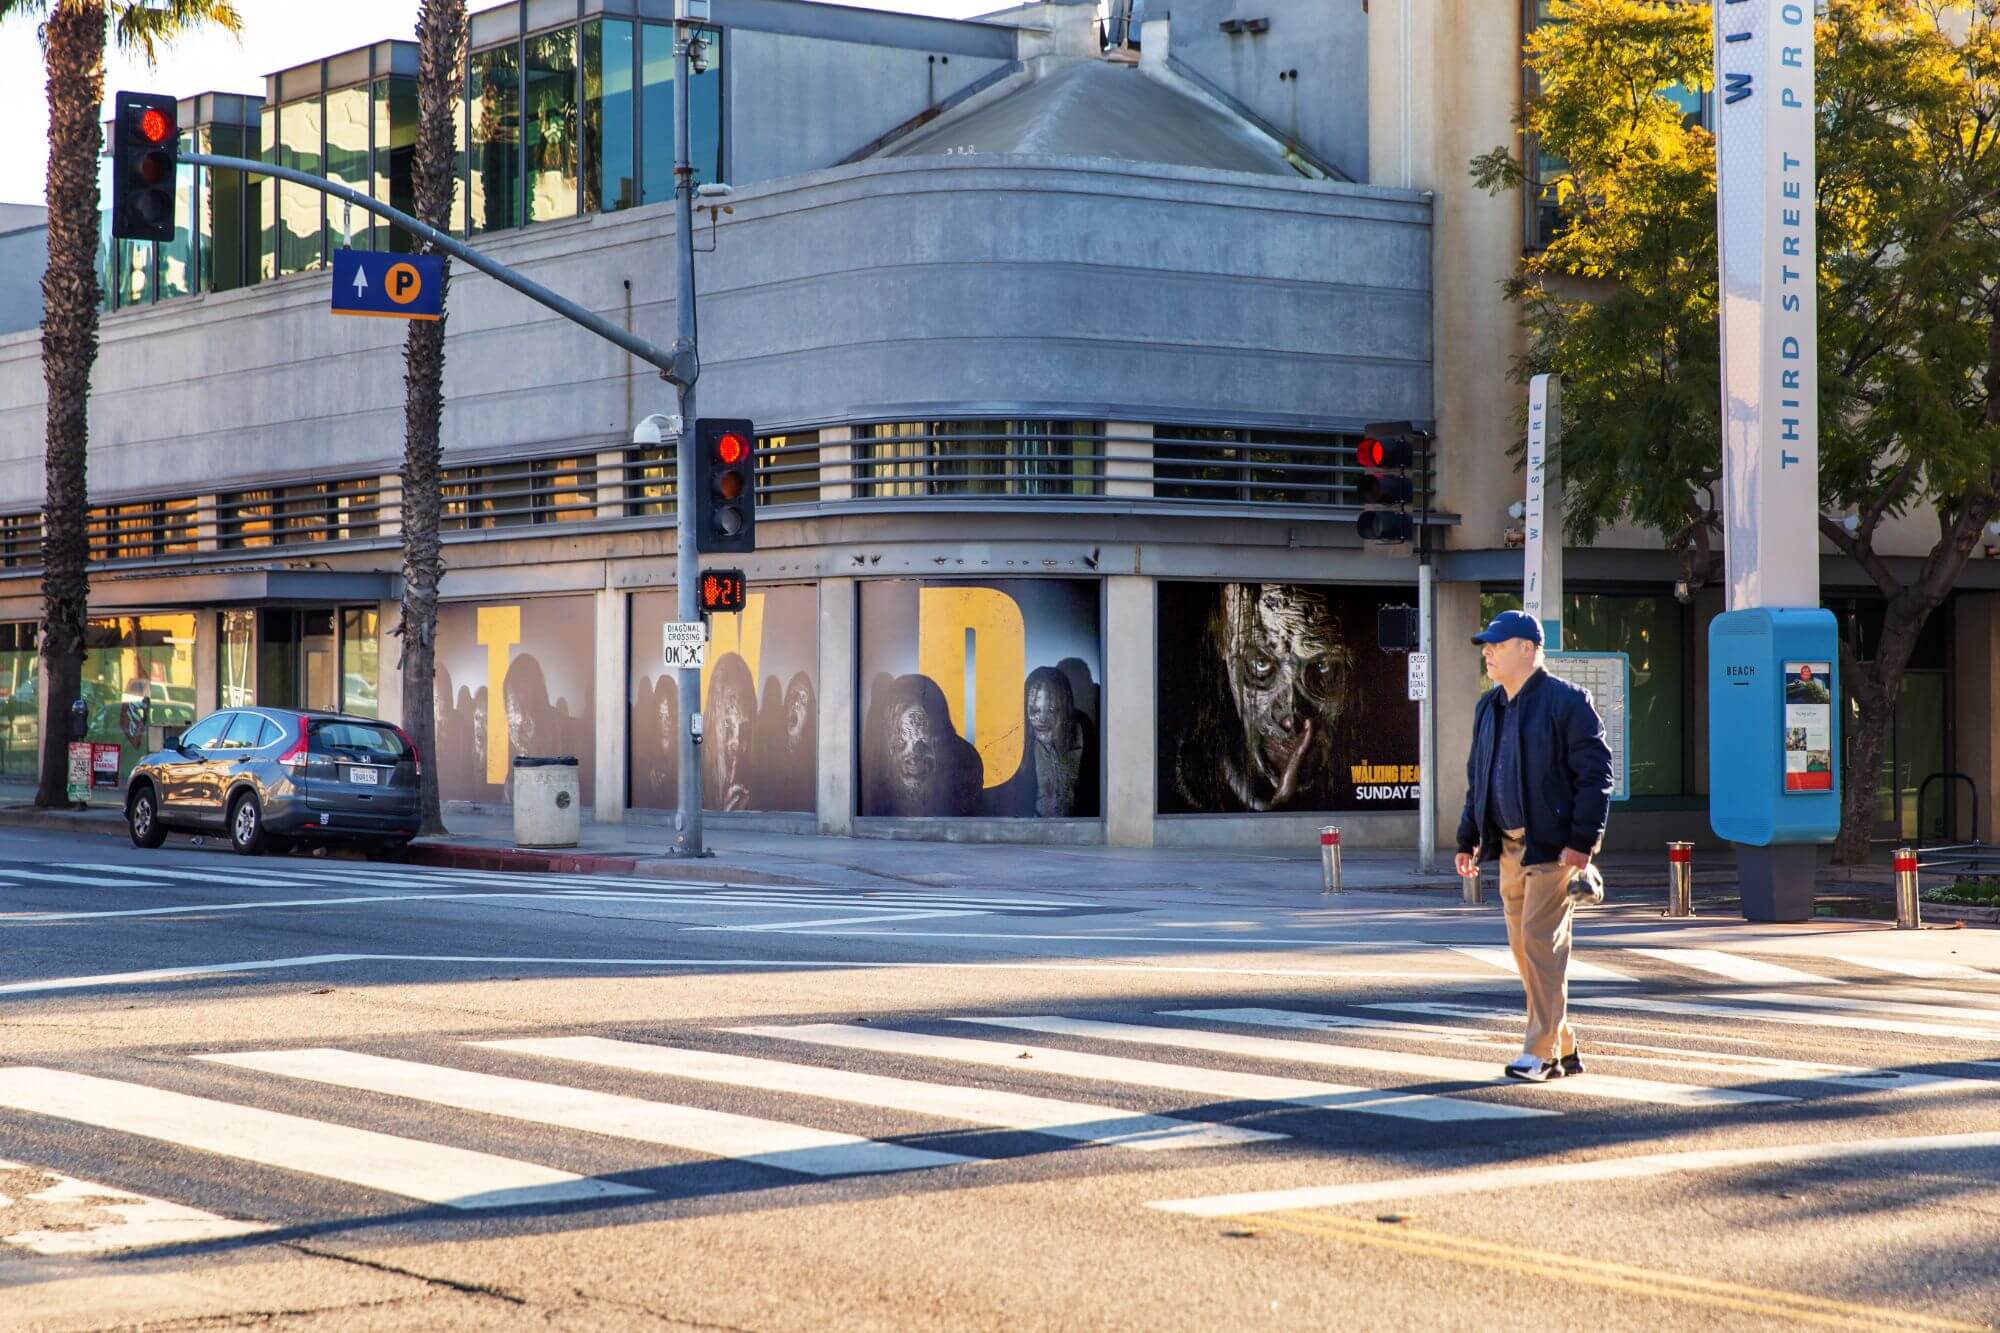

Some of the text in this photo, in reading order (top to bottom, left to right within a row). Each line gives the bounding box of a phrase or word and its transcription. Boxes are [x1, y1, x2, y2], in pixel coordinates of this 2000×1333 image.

[1725, 0, 1752, 104] WI
[1782, 152, 1801, 313] STREET
[396, 271, 414, 296] P
[1782, 336, 1801, 469] THIRD
[1530, 402, 1542, 539] WILSHIRE
[722, 579, 740, 604] 21
[667, 624, 700, 632] DIAGONAL
[668, 633, 700, 641] CROSSING
[665, 646, 680, 663] OK
[1411, 655, 1426, 663] CROSS
[1726, 666, 1755, 676] BEACH
[477, 606, 521, 785] T
[919, 587, 1025, 789] D
[1351, 765, 1399, 784] WALKING
[1356, 785, 1409, 800] SUNDAY
